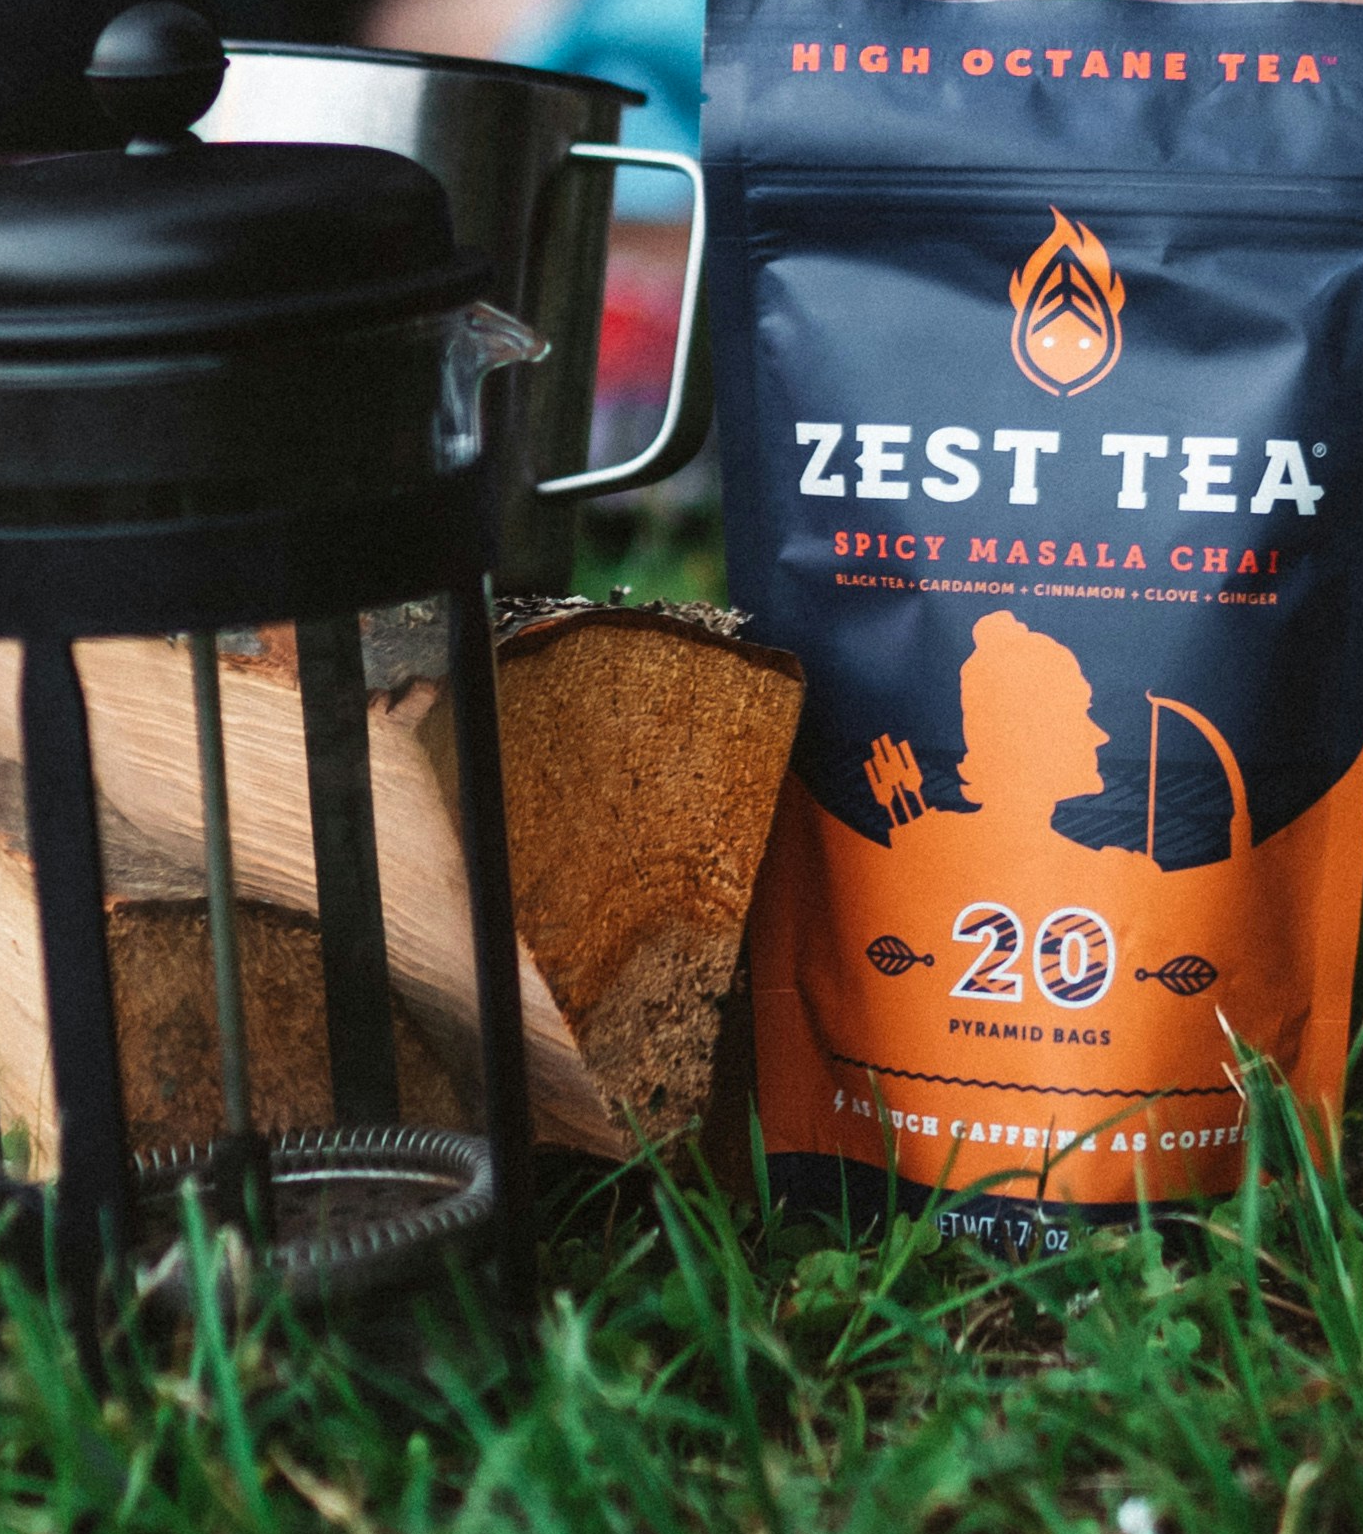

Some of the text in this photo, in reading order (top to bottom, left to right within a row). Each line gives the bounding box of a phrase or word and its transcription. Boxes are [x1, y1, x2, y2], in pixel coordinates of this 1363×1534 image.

[791, 43, 930, 74] HIGH
[963, 49, 1187, 81] OCTANE
[795, 422, 1326, 516] ZEST TEA
[834, 531, 1279, 574] SPICY MASALA CHAI
[835, 573, 877, 587] BLACK
[880, 576, 905, 589] TEA
[919, 578, 1015, 595] CARDAMOM
[1033, 583, 1126, 600] CINNAMON
[1144, 587, 1199, 603] CLOVE
[1217, 591, 1279, 606] GINGER
[949, 901, 1117, 1010] 20
[949, 1018, 1112, 1047] PYRAMID BAGS
[852, 1096, 872, 1118] AS
[878, 1105, 940, 1137] UCH
[1110, 1132, 1147, 1152] AS
[933, 1212, 961, 1238] ET
[1045, 1229, 1070, 1251] OZ
